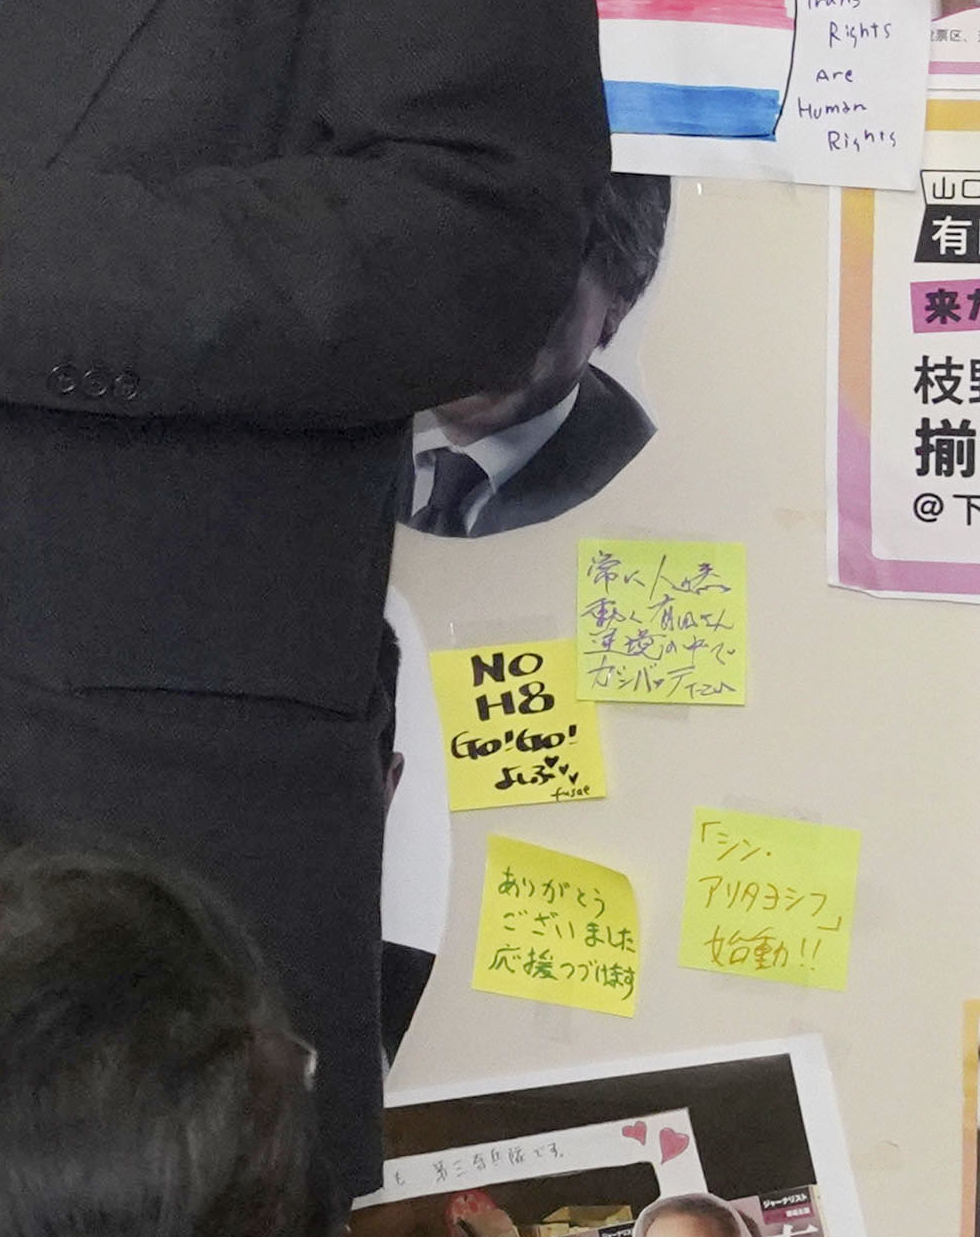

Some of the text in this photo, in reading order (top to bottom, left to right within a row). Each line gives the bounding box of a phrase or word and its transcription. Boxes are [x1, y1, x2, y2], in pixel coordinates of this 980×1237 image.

[829, 22, 892, 48] Rights
[815, 68, 854, 83] Are
[798, 97, 867, 120] Human
[827, 129, 897, 152] Rights
[931, 215, 980, 256] 有
[471, 652, 544, 687] NO
[476, 681, 555, 721] H8
[498, 866, 606, 918] ありがとう
[503, 910, 636, 953] ございました
[489, 944, 635, 1001] 応援つづけます
